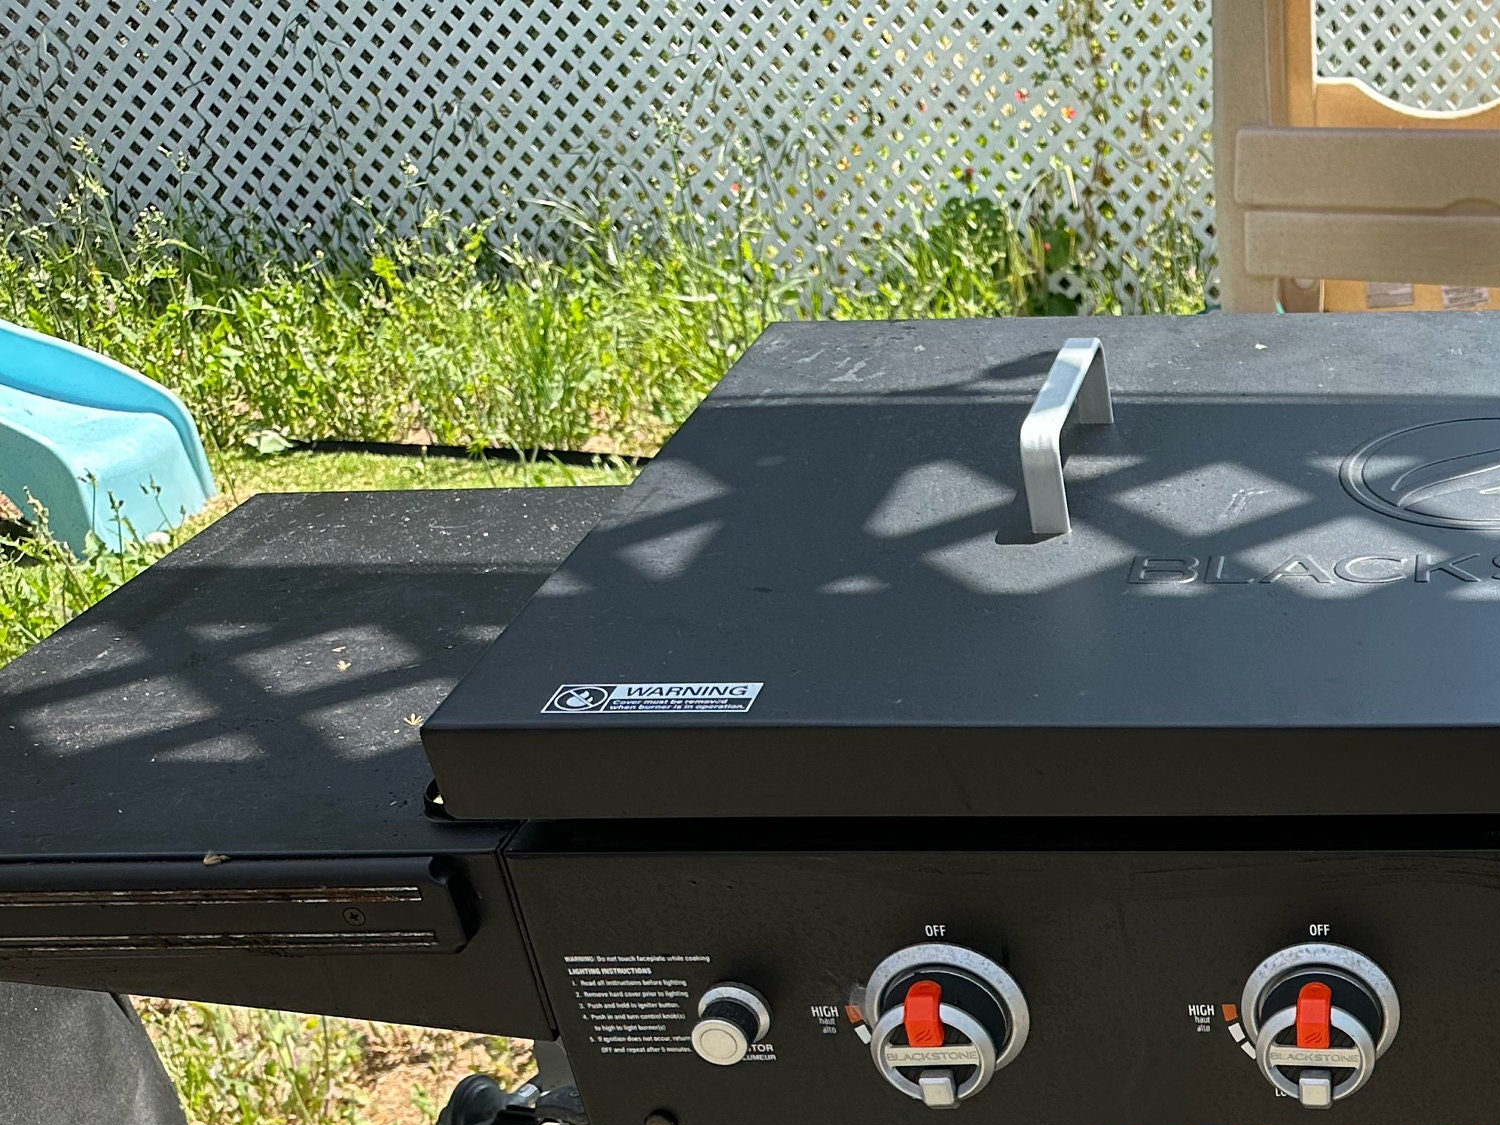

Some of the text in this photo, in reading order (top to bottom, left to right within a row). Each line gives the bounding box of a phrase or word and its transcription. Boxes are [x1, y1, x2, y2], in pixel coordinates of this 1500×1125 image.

[626, 685, 749, 697] WARNING
[924, 925, 946, 937] OFF
[1309, 924, 1330, 936] OFF
[811, 1006, 839, 1018] HIGH
[1188, 1004, 1215, 1016] HIGH
[886, 1050, 978, 1062] BLACKSTONE
[1270, 1052, 1359, 1062] BLACKSTONE
